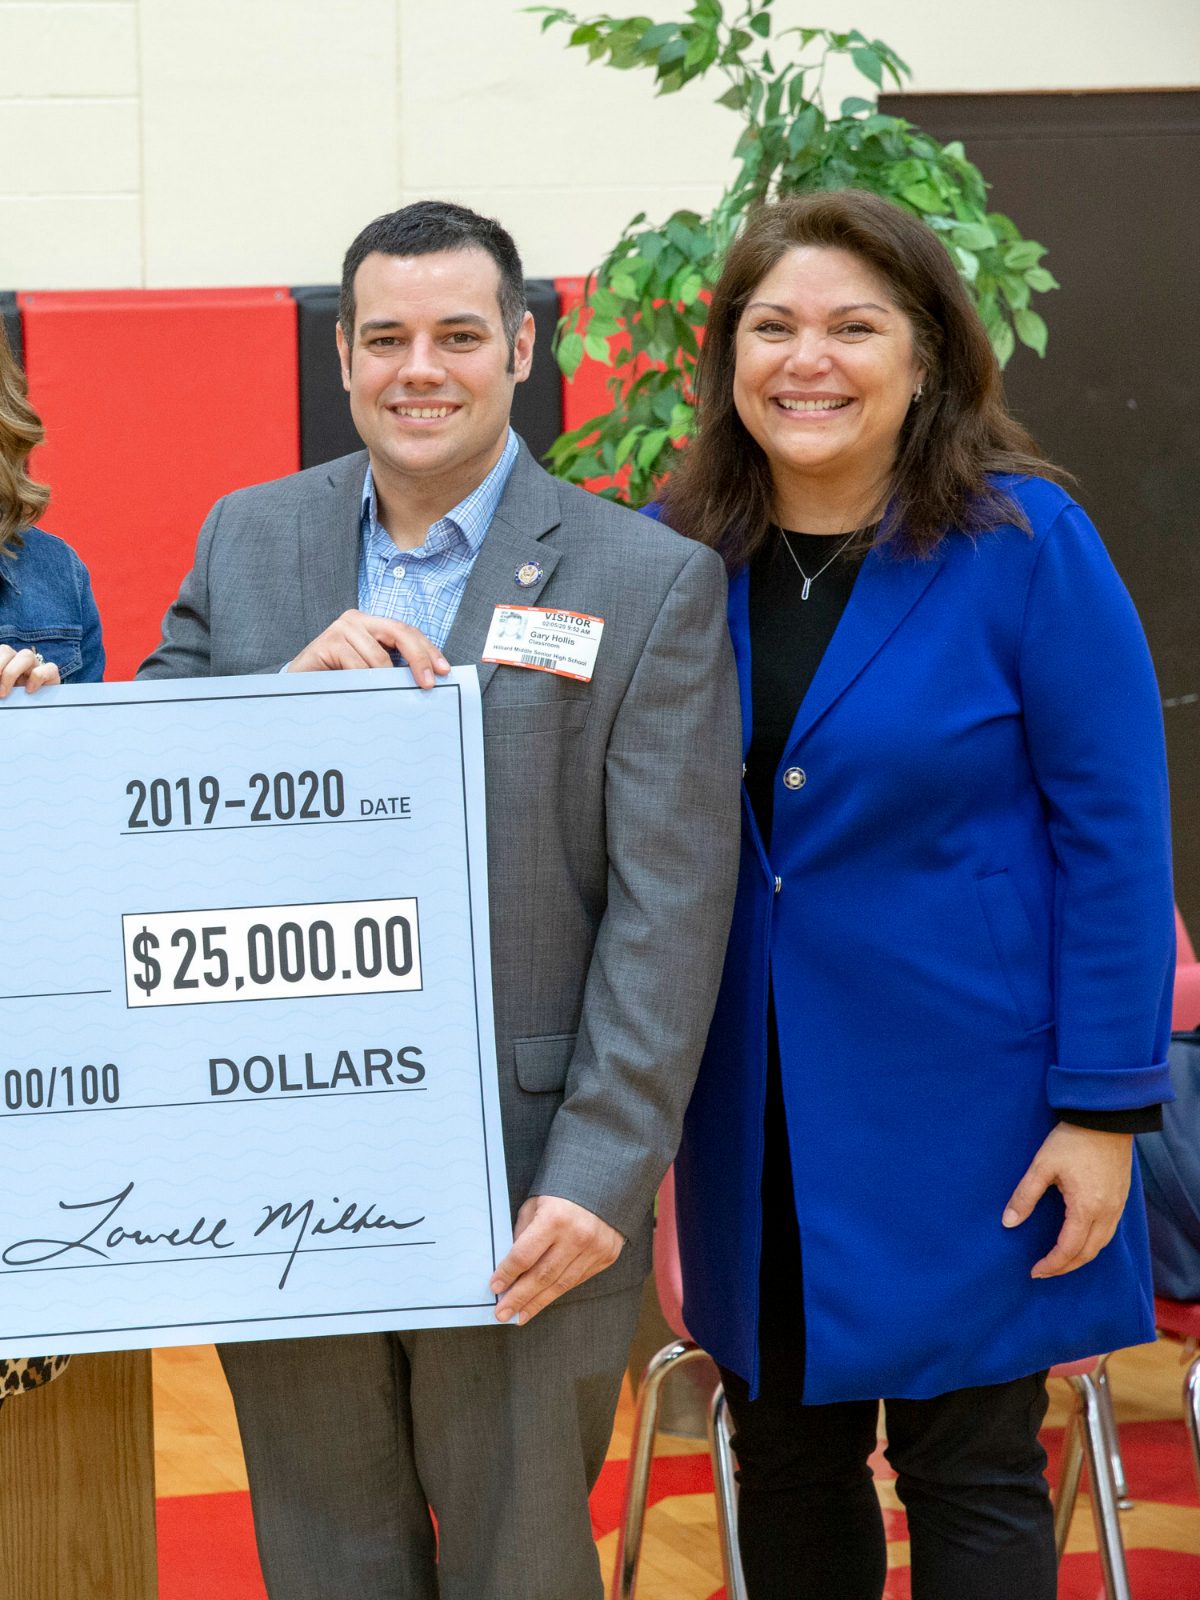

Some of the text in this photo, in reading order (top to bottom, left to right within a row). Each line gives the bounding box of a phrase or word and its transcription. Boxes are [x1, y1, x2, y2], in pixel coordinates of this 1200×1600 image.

[530, 631, 575, 646] Gary Hollis
[545, 612, 591, 628] VISITOR
[513, 646, 533, 654] Middle
[533, 650, 552, 658] Senior
[553, 653, 567, 661] High
[567, 656, 587, 666] School
[528, 638, 560, 649] Classroom
[125, 768, 412, 829] 2019-2020 DATE
[132, 915, 414, 997] $25,000.00
[4, 1063, 121, 1110] 00/100
[208, 1046, 426, 1096] DOLLARS
[1, 1181, 235, 1265] Lowell
